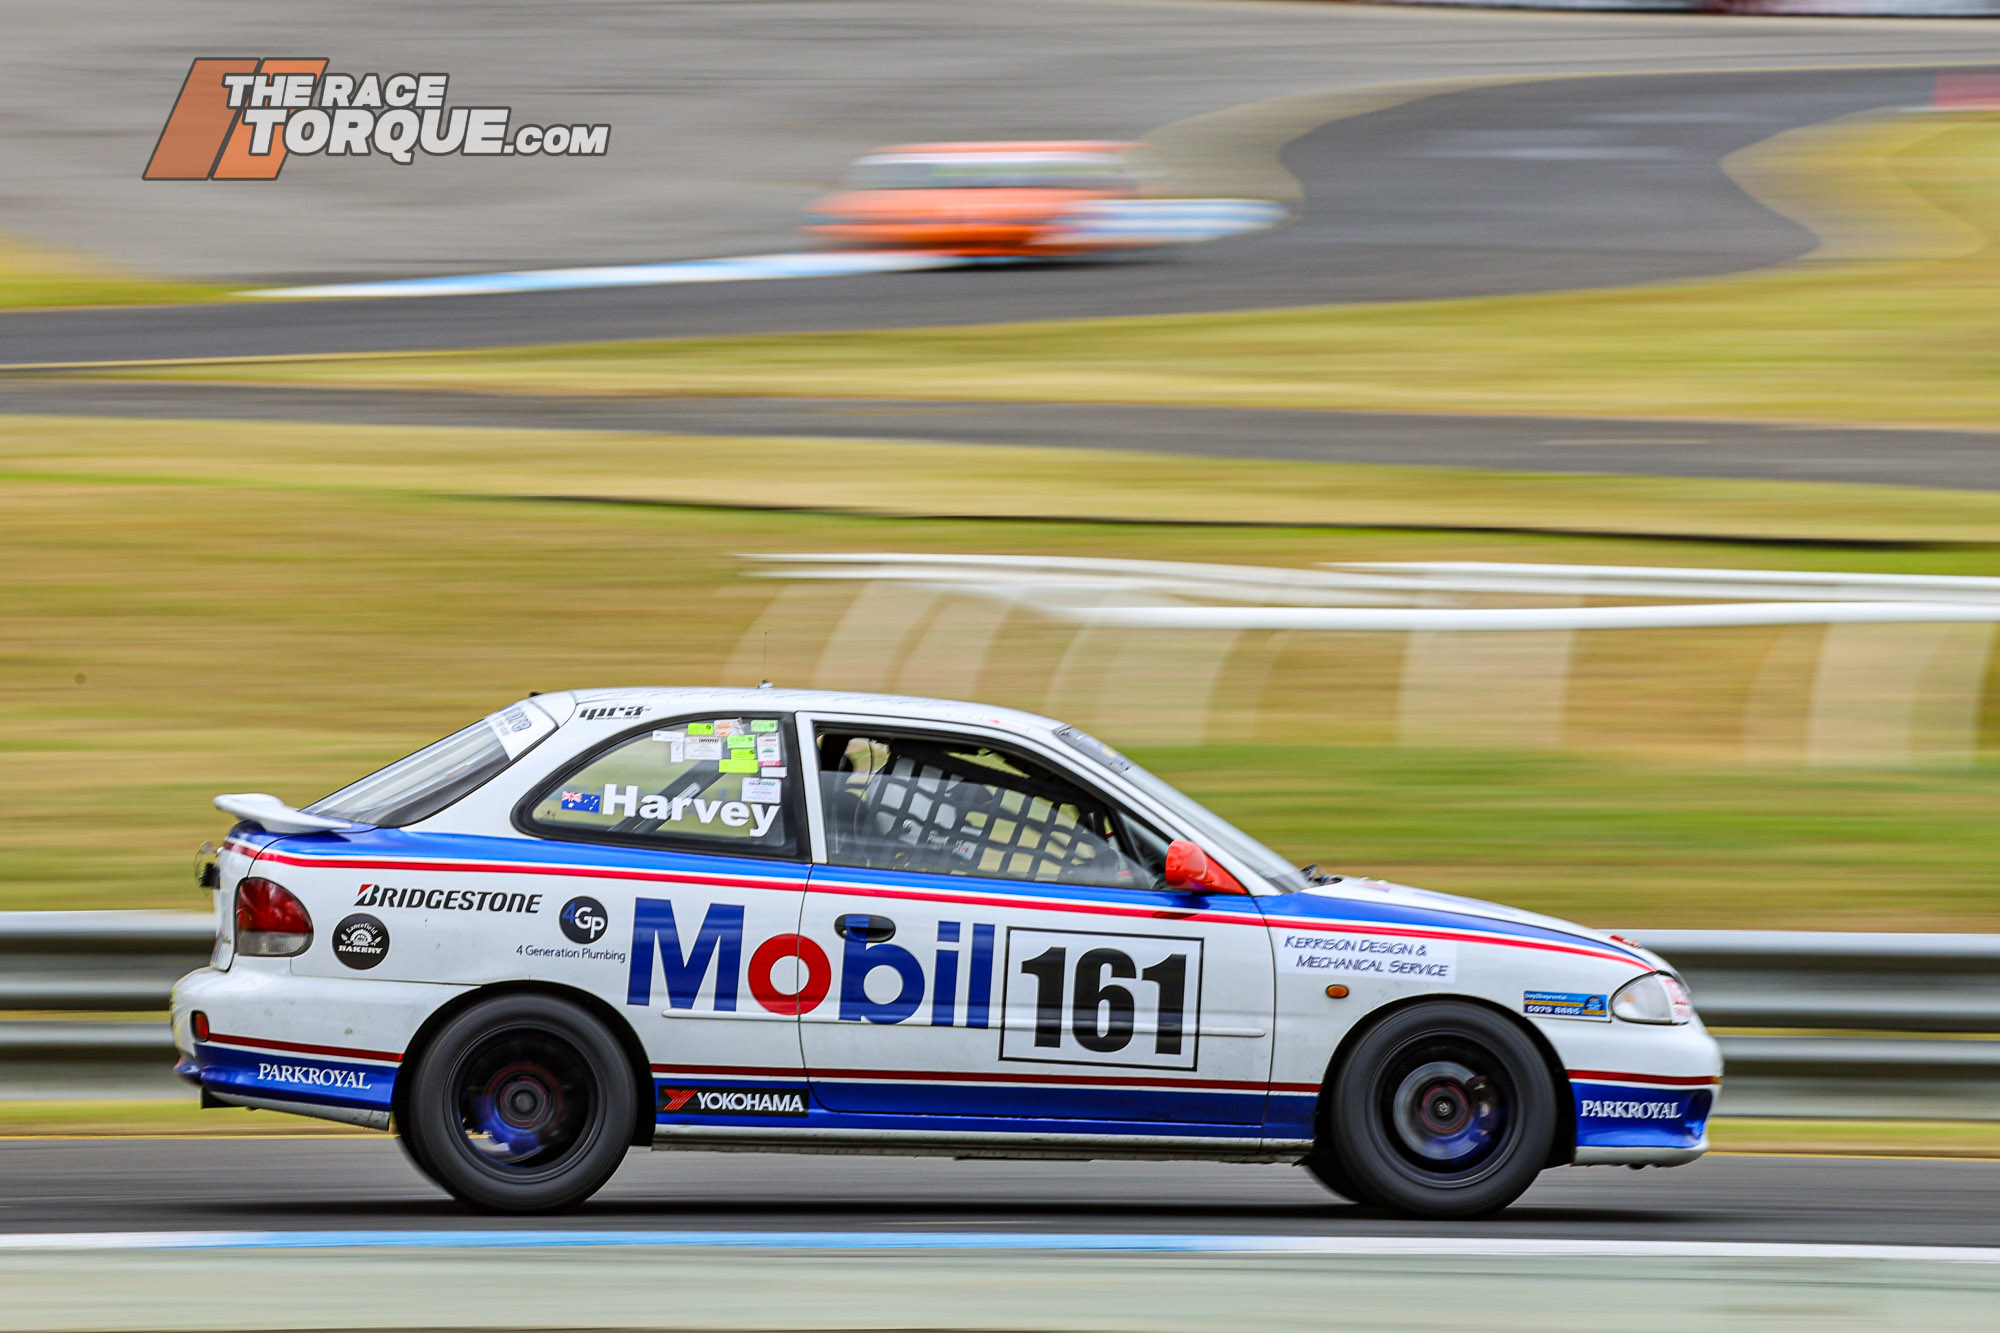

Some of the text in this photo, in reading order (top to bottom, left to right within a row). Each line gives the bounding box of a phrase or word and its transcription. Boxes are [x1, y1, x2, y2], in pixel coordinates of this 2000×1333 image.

[603, 783, 780, 837] Harvey
[353, 883, 543, 914] BRIDGESTONE
[338, 945, 383, 954] BAKERY
[515, 944, 626, 964] 4 Generation Plumbing
[1284, 935, 1427, 956] KERRISON DESIGN &
[627, 897, 996, 1027] Mobil
[1295, 954, 1449, 977] MECHANICAL SERVICE
[1020, 946, 1187, 1056] 161
[256, 1062, 372, 1090] PARKROYAL
[696, 1091, 805, 1112] YOKOHAMA
[1580, 1099, 1682, 1119] PARKROYAL
